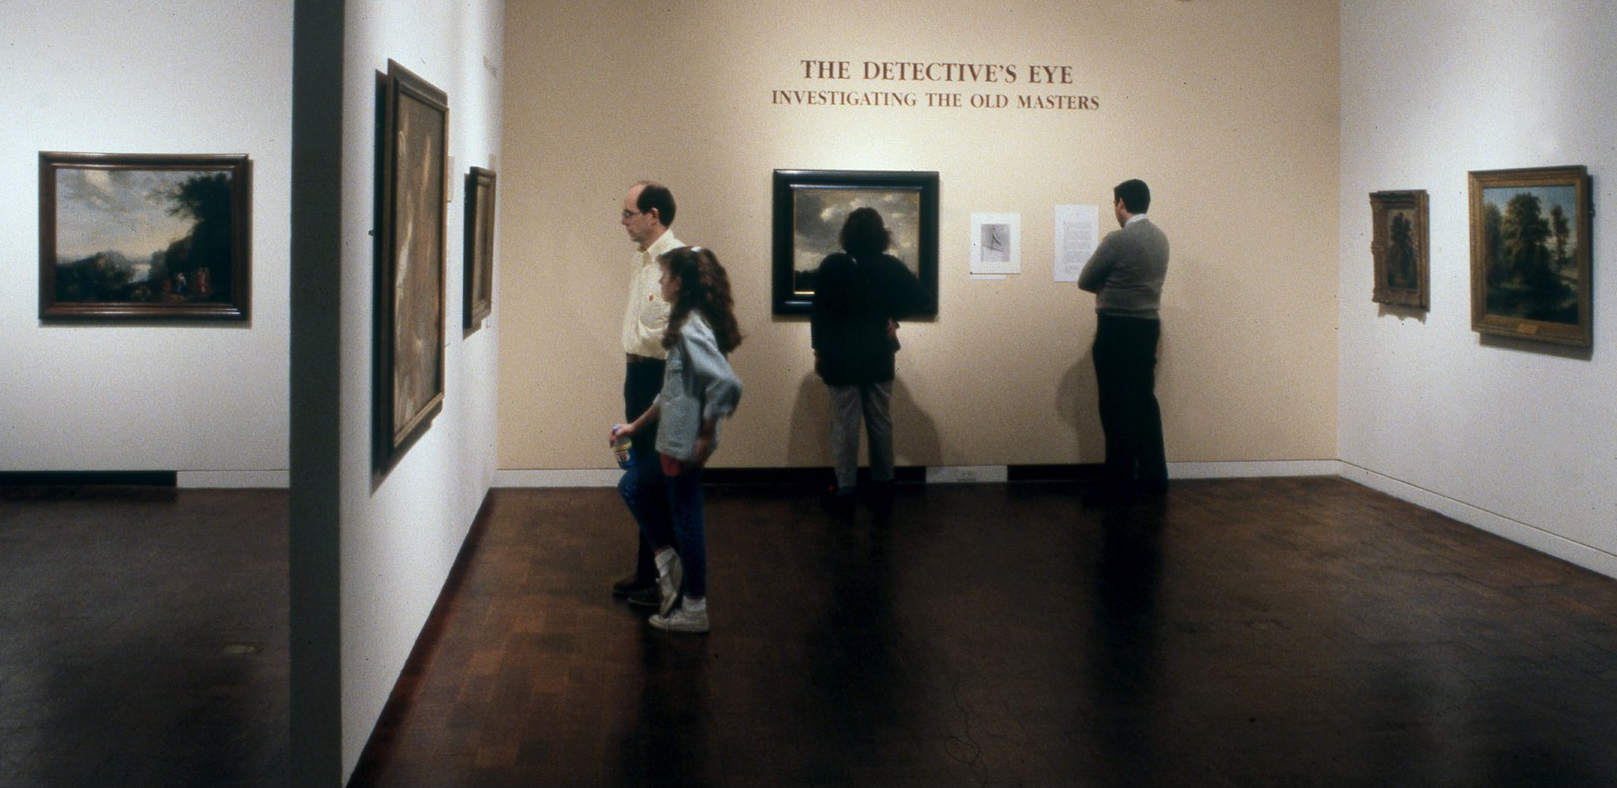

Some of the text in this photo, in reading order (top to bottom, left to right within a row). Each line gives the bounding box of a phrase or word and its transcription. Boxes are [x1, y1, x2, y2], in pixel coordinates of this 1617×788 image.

[800, 59, 1074, 85] THE DETECTIVE'S EYE
[771, 90, 1100, 110] INVESTIGATING THE OLD MASTERS
